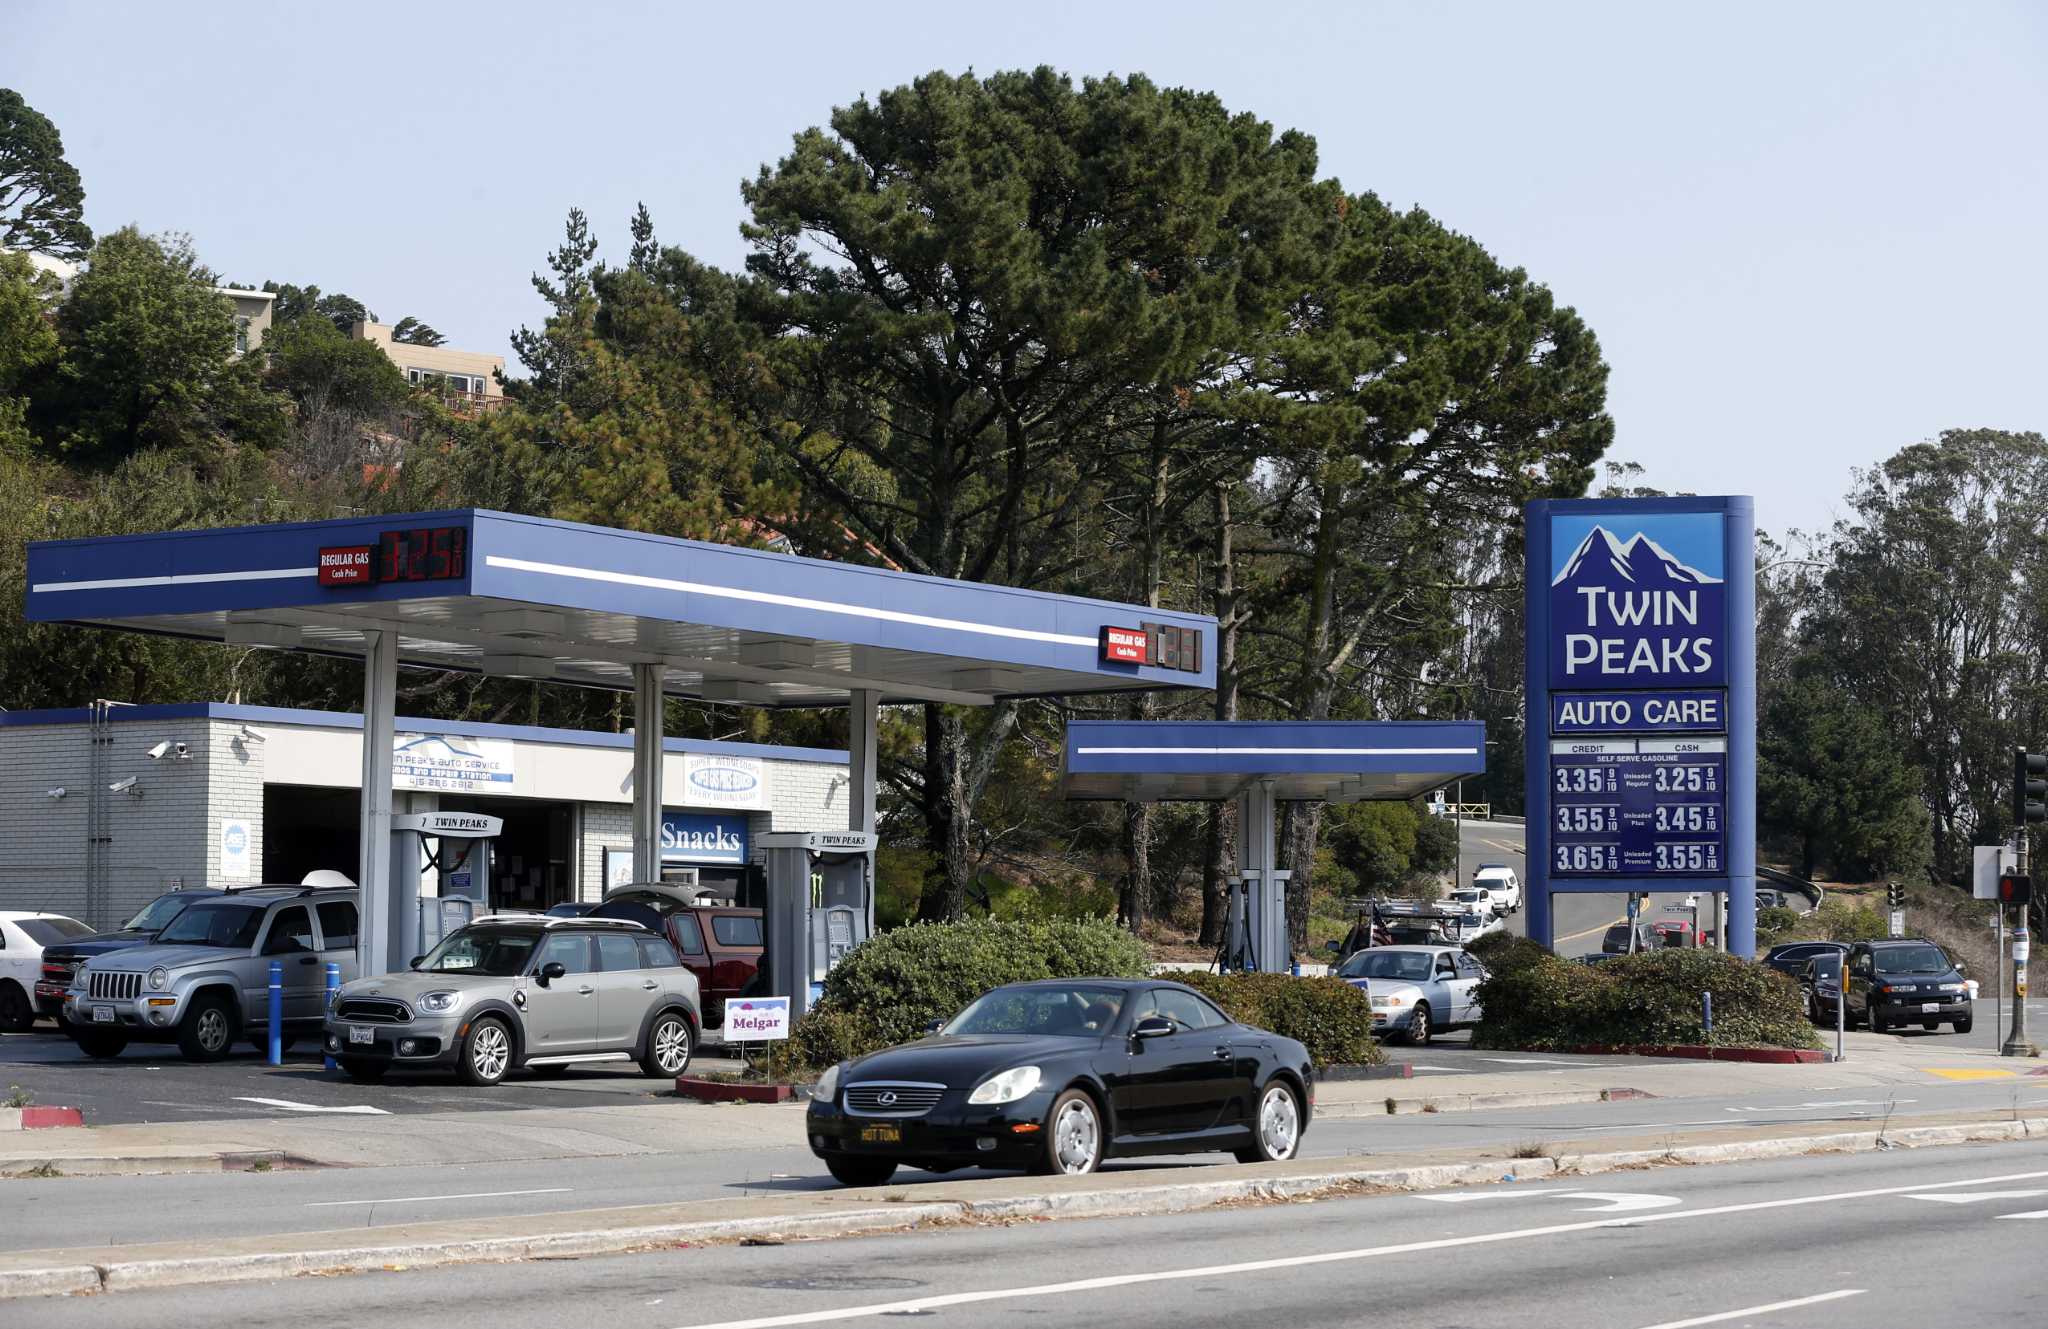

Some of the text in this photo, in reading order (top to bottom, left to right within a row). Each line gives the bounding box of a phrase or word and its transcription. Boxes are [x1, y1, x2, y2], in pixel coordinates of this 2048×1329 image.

[321, 552, 369, 566] REGULAR GAS
[331, 569, 358, 578] Cash Price
[1577, 586, 1698, 627] TWIN
[1109, 632, 1146, 648] REGULAR GAS
[1565, 633, 1713, 675] PEAKS
[1559, 699, 1718, 725] AUTO CARE
[1572, 745, 1605, 753] CREDIT
[1675, 744, 1699, 752] CASH
[1556, 768, 1602, 792] 3.35
[1655, 767, 1701, 792] 3.25
[435, 817, 457, 827] TWIN
[459, 819, 488, 829] PEAKS
[1558, 807, 1603, 832] 3.55
[1655, 806, 1702, 831] 3.45
[661, 822, 740, 851] Snacks
[810, 835, 866, 845] 5 TWIN PEAKS
[1557, 846, 1603, 870] 3.65
[1656, 845, 1702, 869] 3.55
[733, 1017, 780, 1031] Melgar
[862, 1129, 877, 1141] HOT
